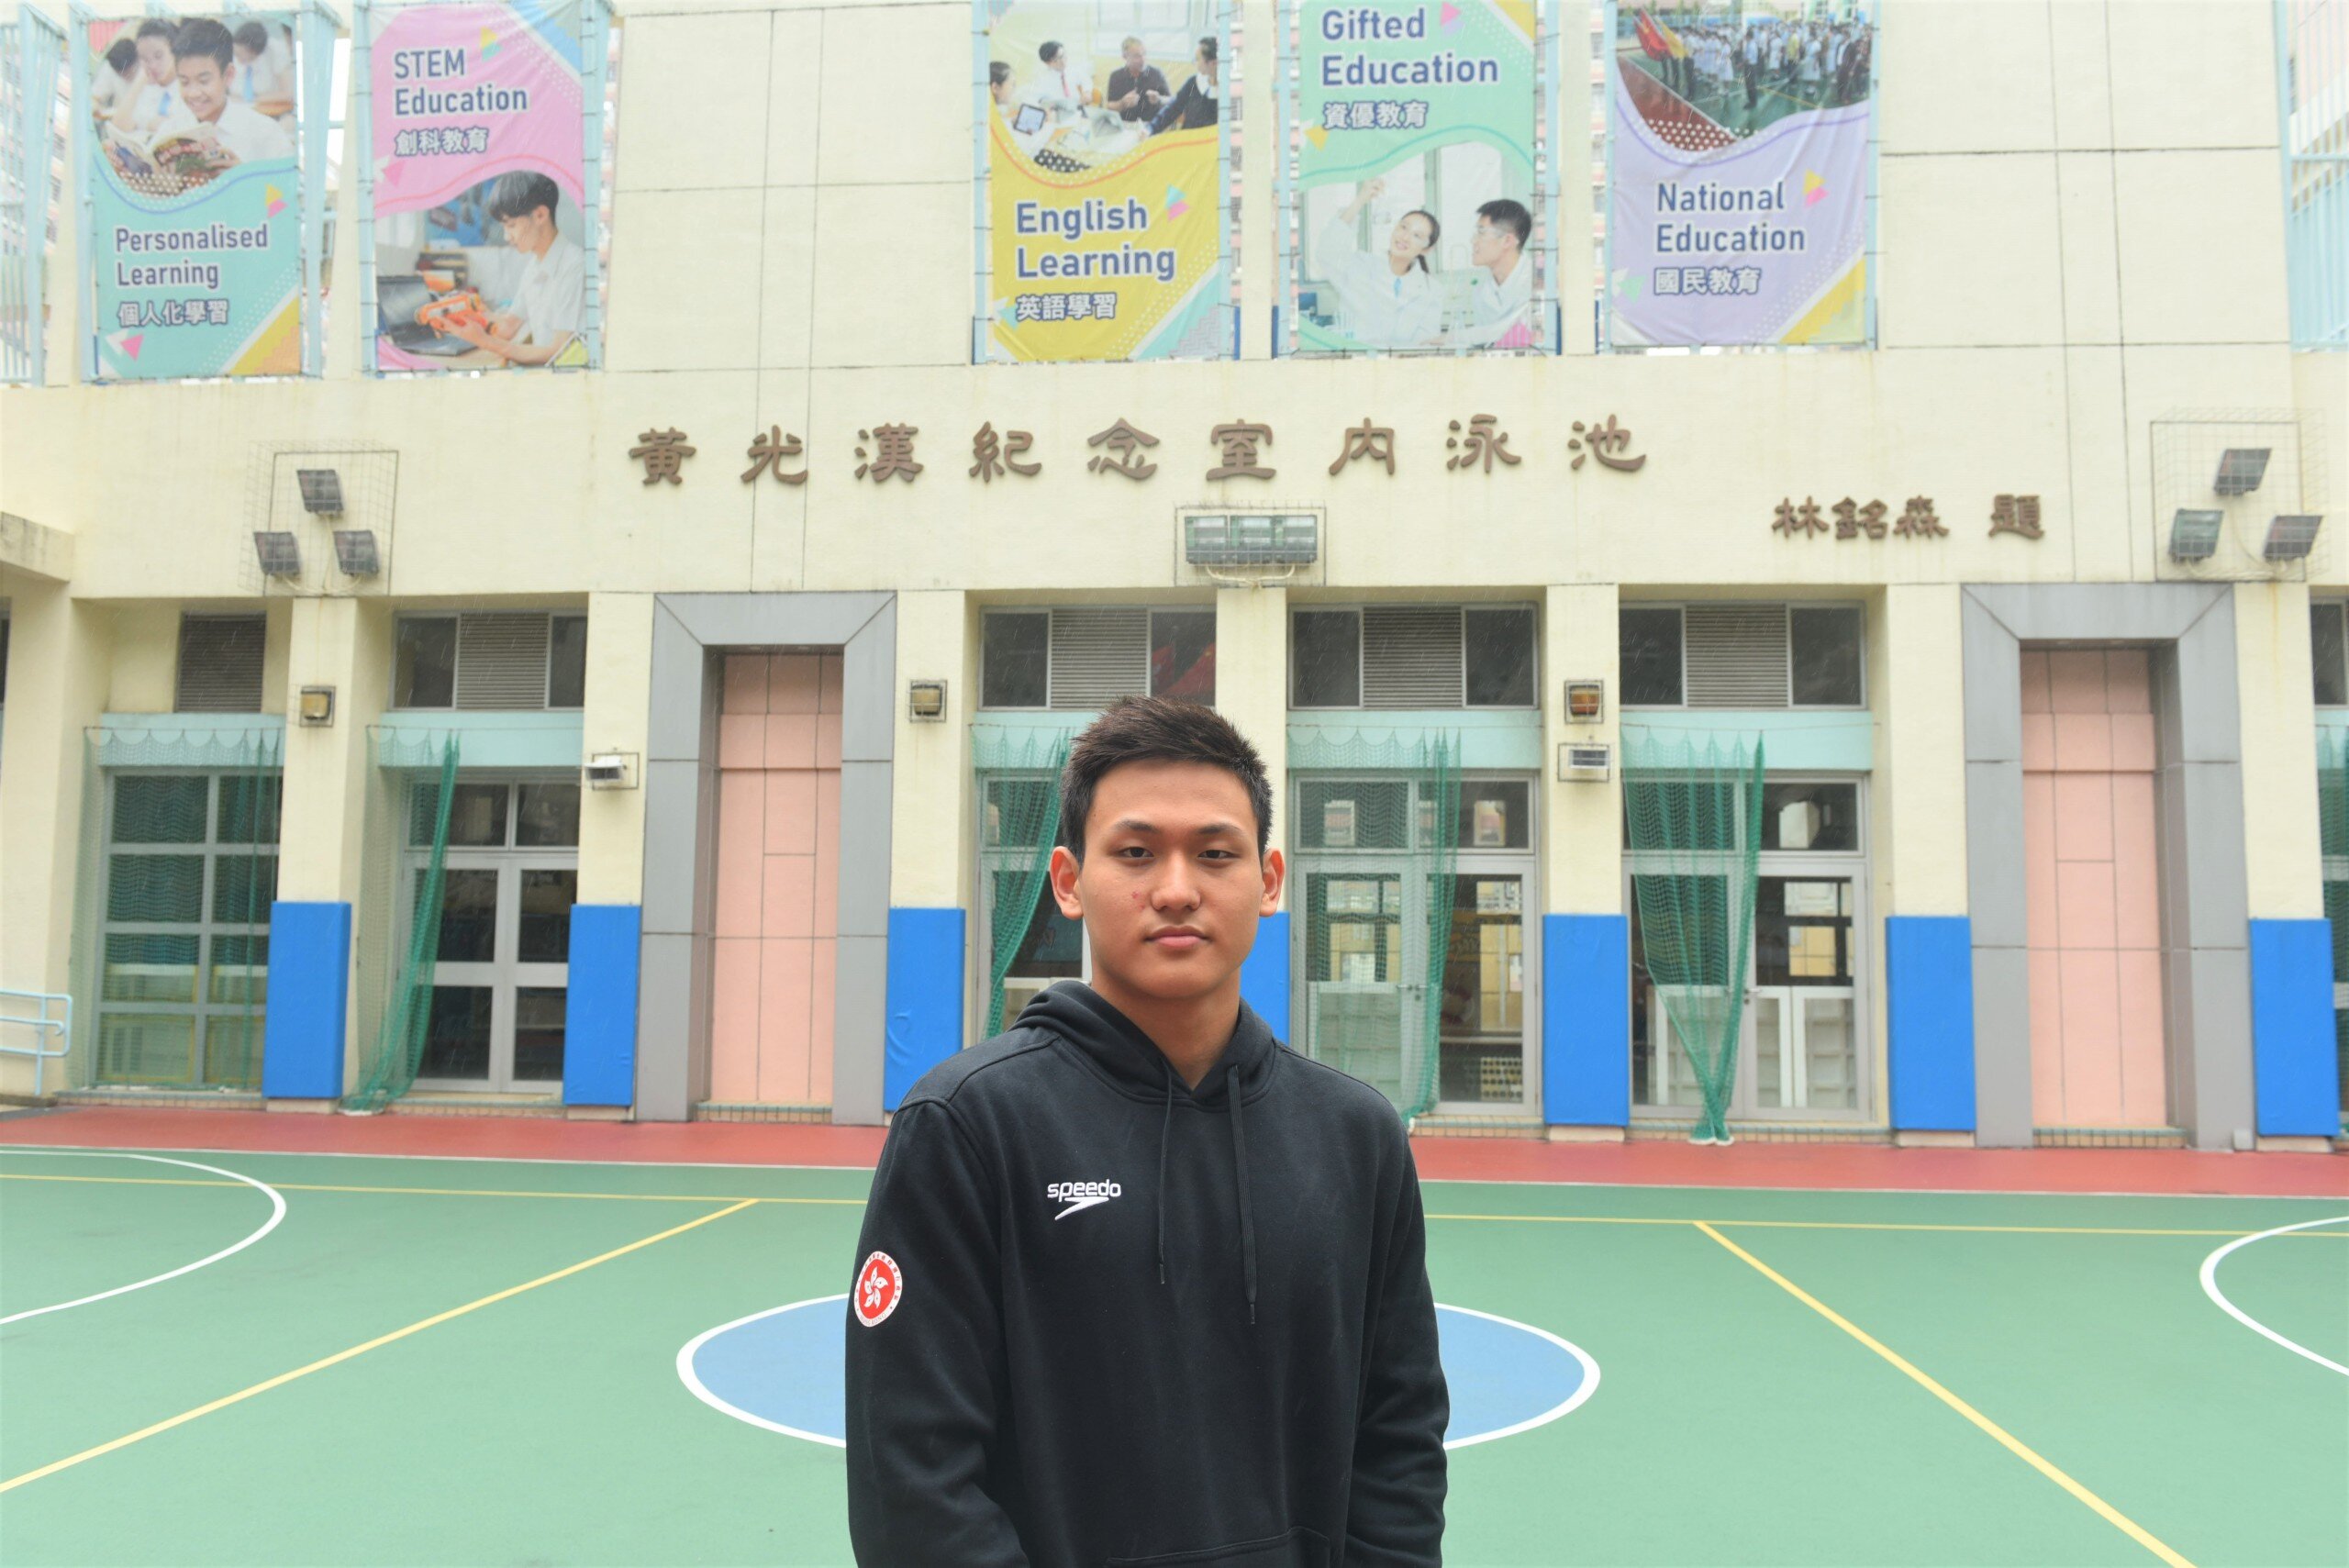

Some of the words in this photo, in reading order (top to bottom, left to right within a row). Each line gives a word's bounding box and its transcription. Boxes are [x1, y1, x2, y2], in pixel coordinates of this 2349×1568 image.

[1321, 7, 1426, 41] Gifted
[394, 48, 465, 80] STEM
[1321, 52, 1499, 86] Education
[395, 83, 528, 117] Education
[1322, 100, 1429, 130] 資優教育
[394, 126, 490, 157] 創科教育
[1656, 181, 1786, 212] National
[1016, 198, 1148, 240] English
[116, 223, 268, 252] Personalised
[1656, 222, 1806, 253] Education
[117, 259, 219, 290] Learning
[1017, 243, 1175, 283] Learning
[1653, 266, 1762, 296] 國民教育
[117, 299, 229, 328] 個人化學習
[1015, 291, 1118, 321] 英語學習
[1047, 1178, 1121, 1203] speedo
